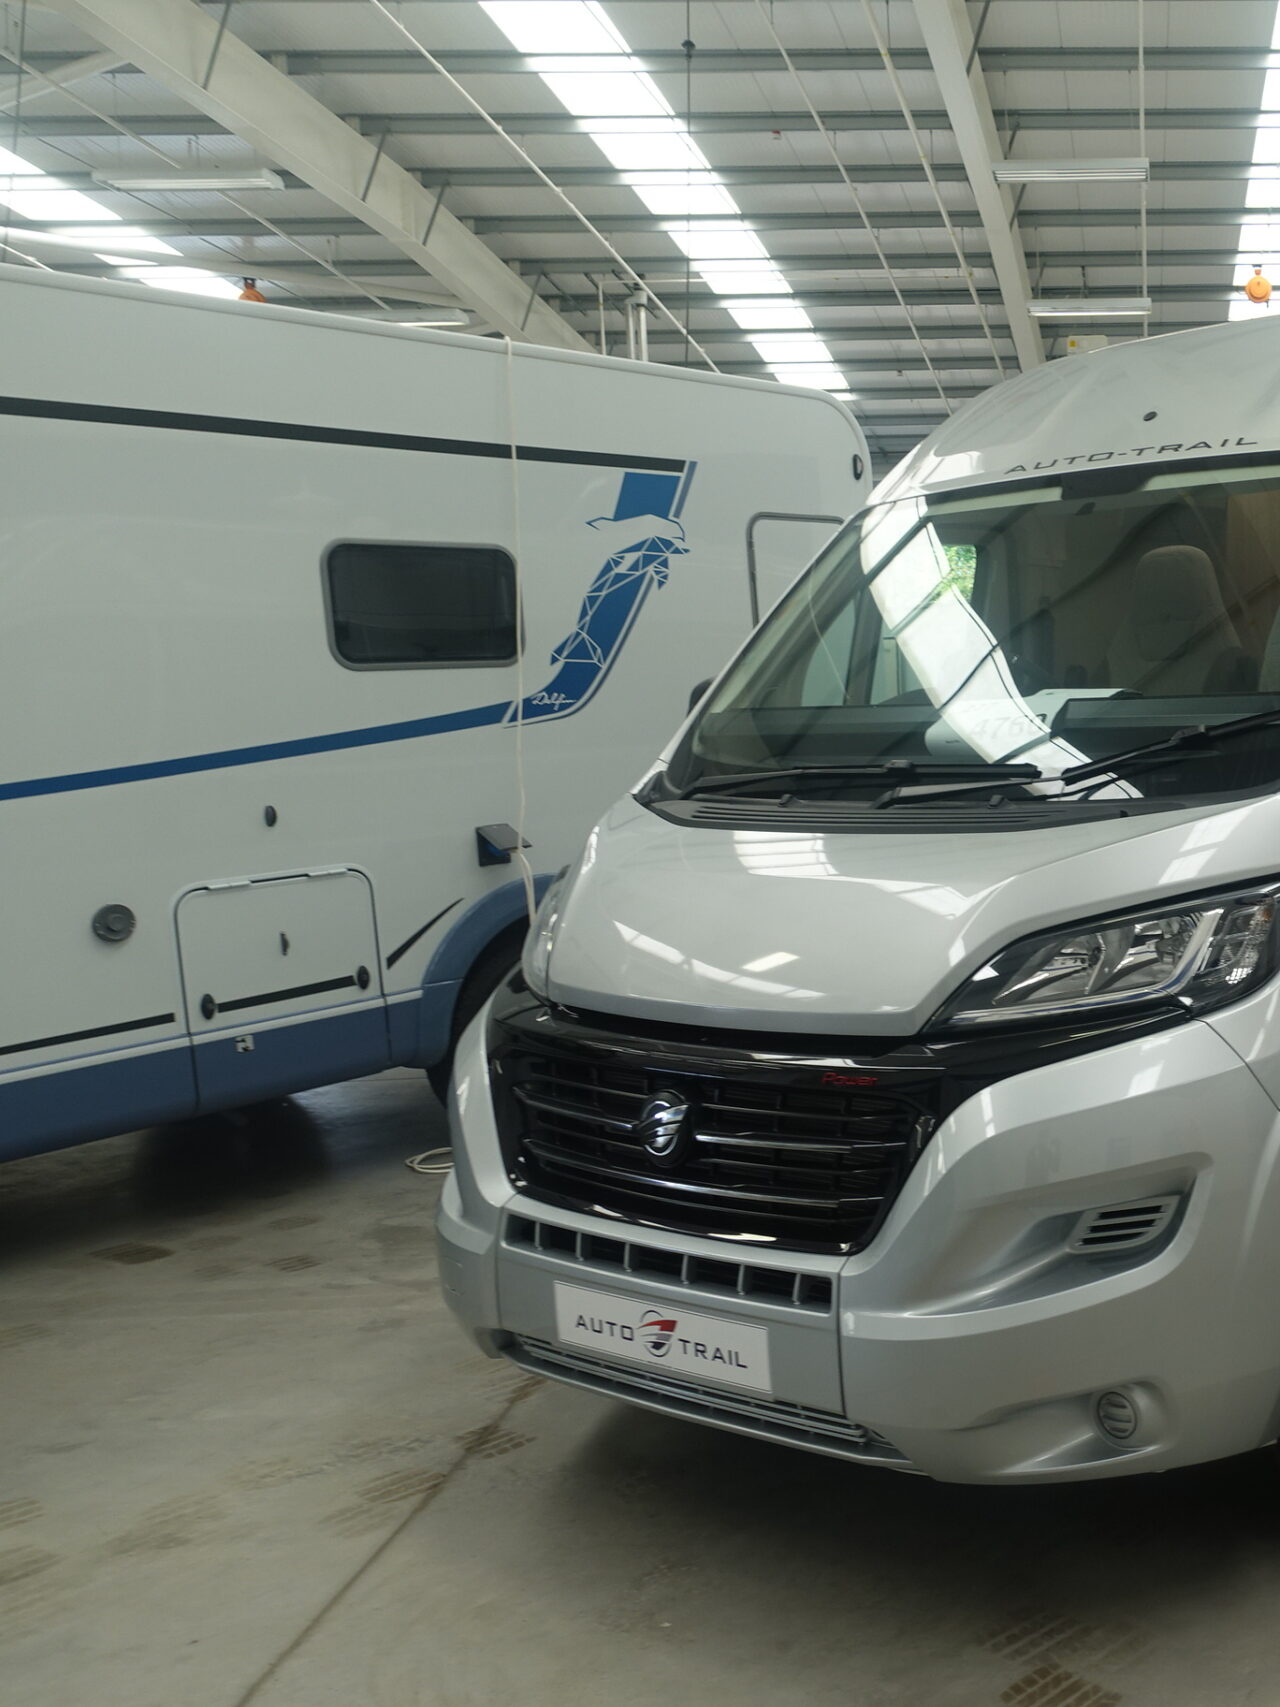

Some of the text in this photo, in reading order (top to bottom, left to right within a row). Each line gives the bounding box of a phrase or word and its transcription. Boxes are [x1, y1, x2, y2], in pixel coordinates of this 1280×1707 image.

[1004, 438, 1258, 475] AUTO-TRAIL
[822, 1072, 878, 1086] Power
[575, 1315, 748, 1369] AUTO TRAIL
